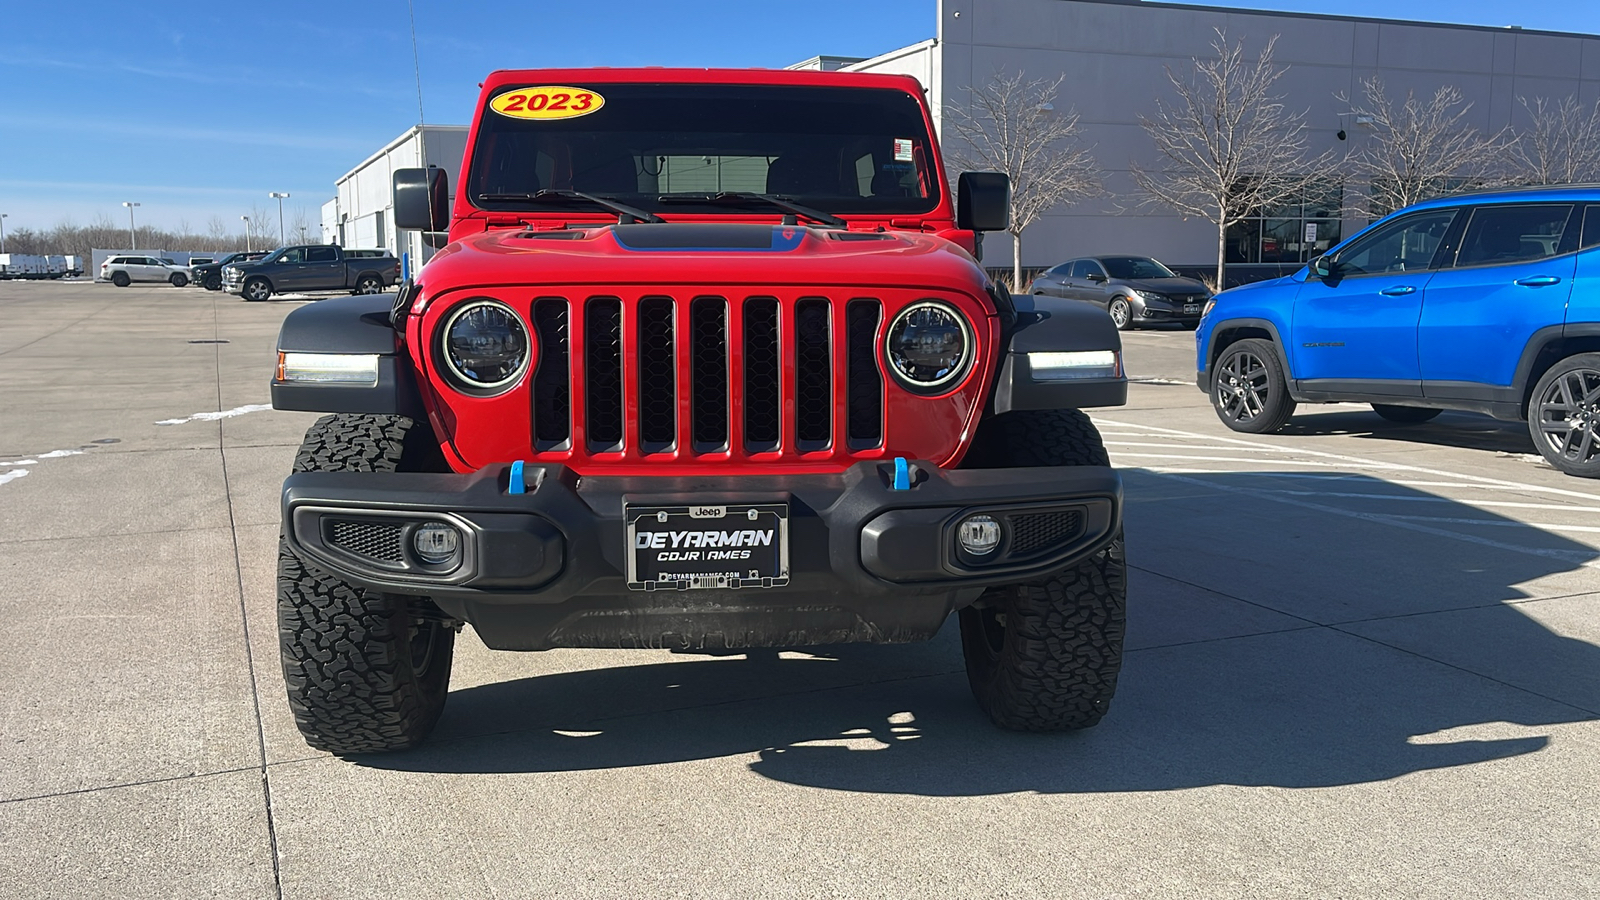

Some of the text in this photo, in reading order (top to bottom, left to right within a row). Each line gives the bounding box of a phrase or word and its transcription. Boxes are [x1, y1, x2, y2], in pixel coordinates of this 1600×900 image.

[502, 93, 594, 112] 2023
[695, 508, 720, 516] Jeep
[635, 530, 773, 549] DEYARMAN
[657, 550, 751, 561] CDJR AMES
